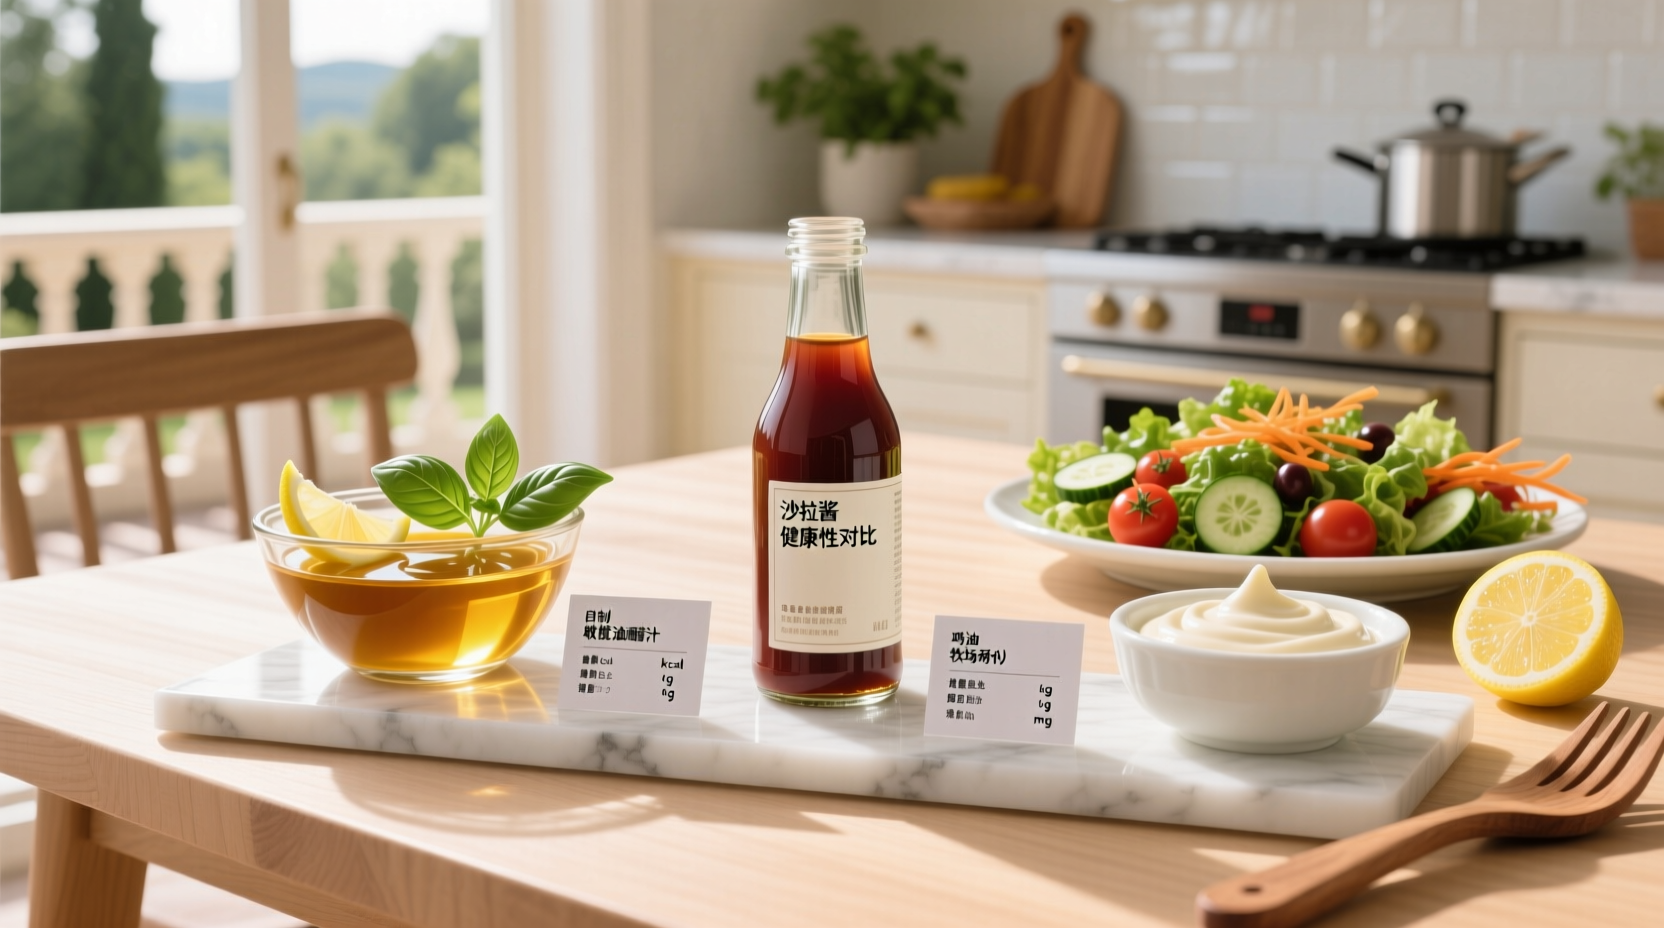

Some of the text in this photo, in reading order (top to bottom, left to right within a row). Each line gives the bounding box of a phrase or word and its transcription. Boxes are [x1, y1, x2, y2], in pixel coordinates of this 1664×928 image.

[780, 499, 839, 522] 沙拉酱
[780, 525, 877, 549] 健康性对比
[1033, 716, 1053, 729] mg
